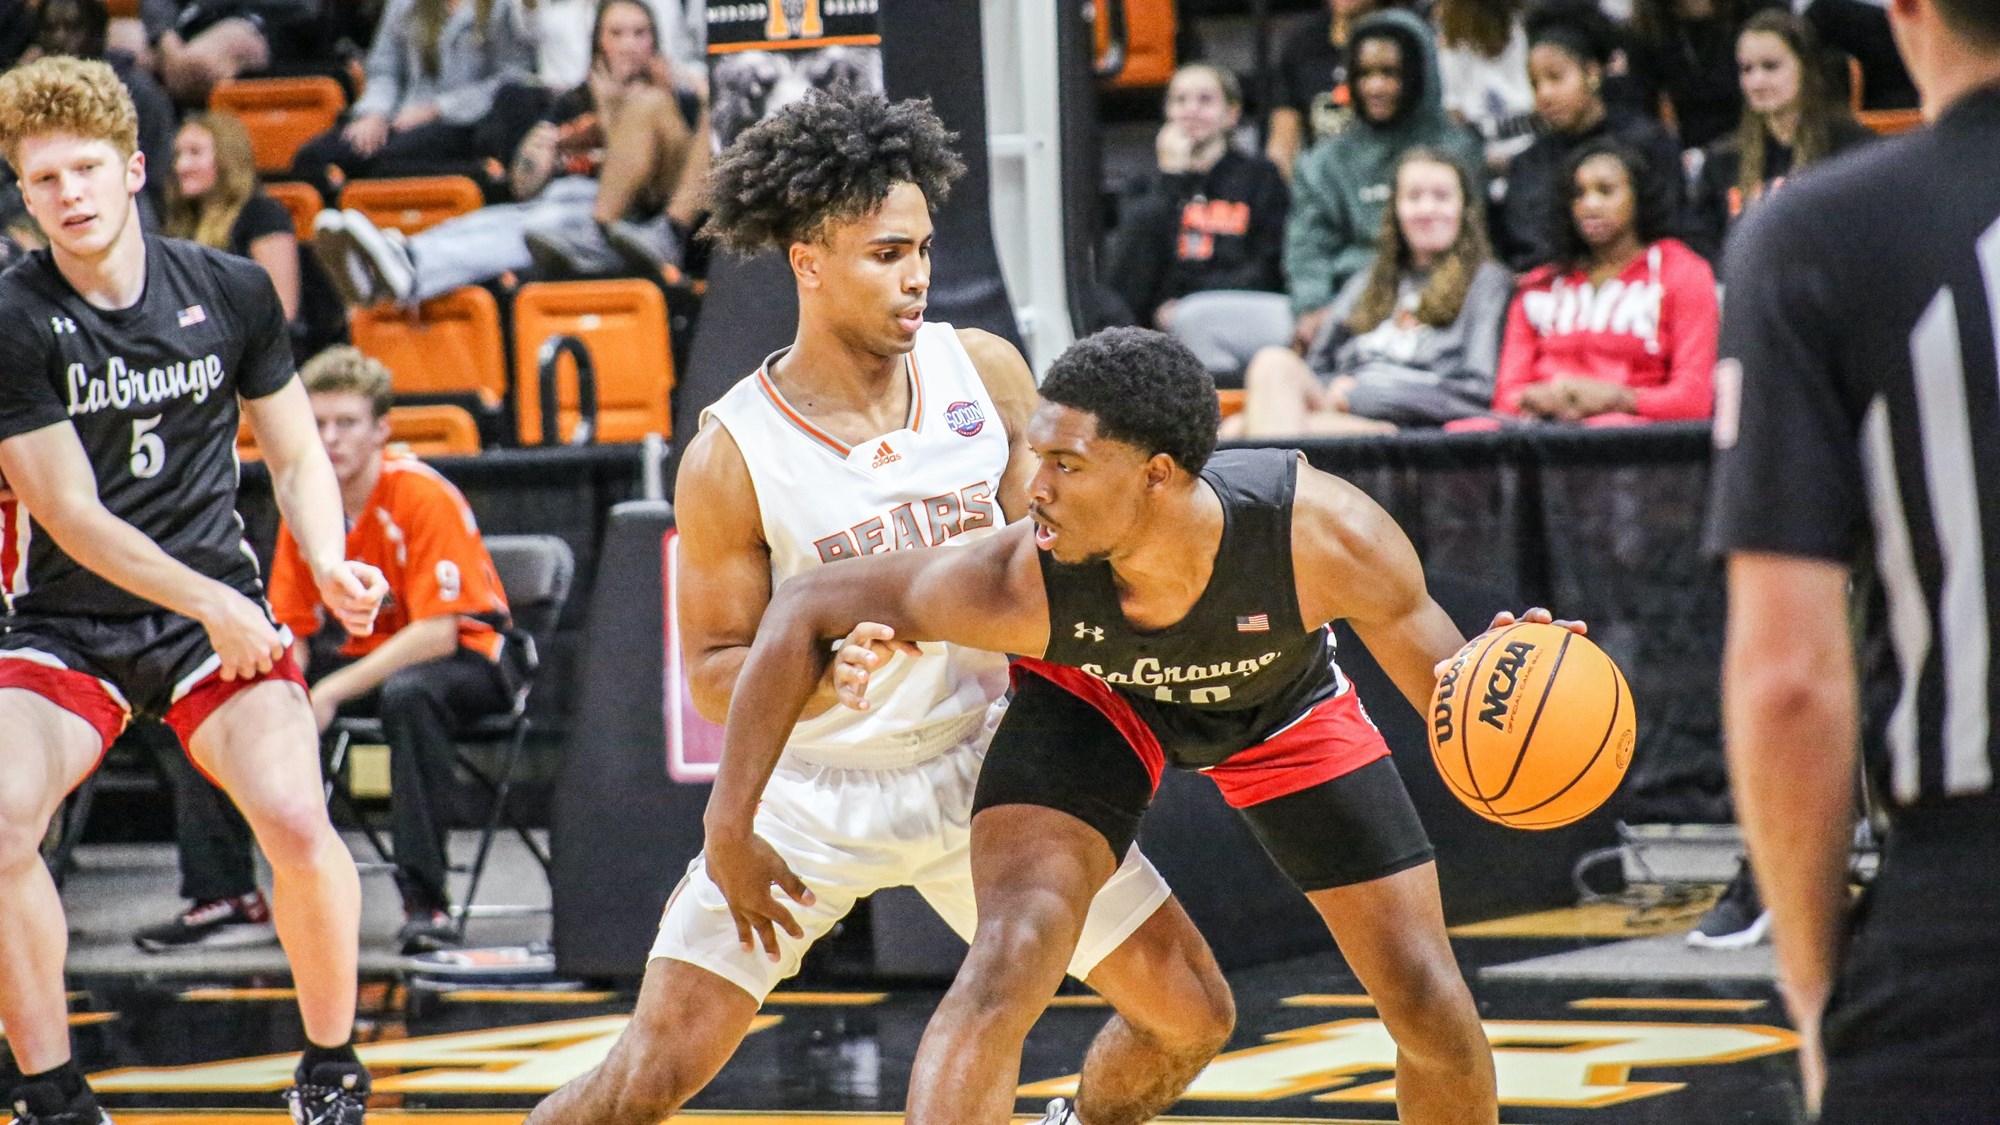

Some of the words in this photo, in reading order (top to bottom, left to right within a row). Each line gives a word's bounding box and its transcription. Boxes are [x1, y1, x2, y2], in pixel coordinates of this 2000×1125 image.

[66, 353, 225, 415] LaGrange
[130, 413, 166, 478] 5
[872, 452, 902, 469] adidas
[813, 481, 994, 564] BEARS
[1479, 641, 1536, 731] NCAA
